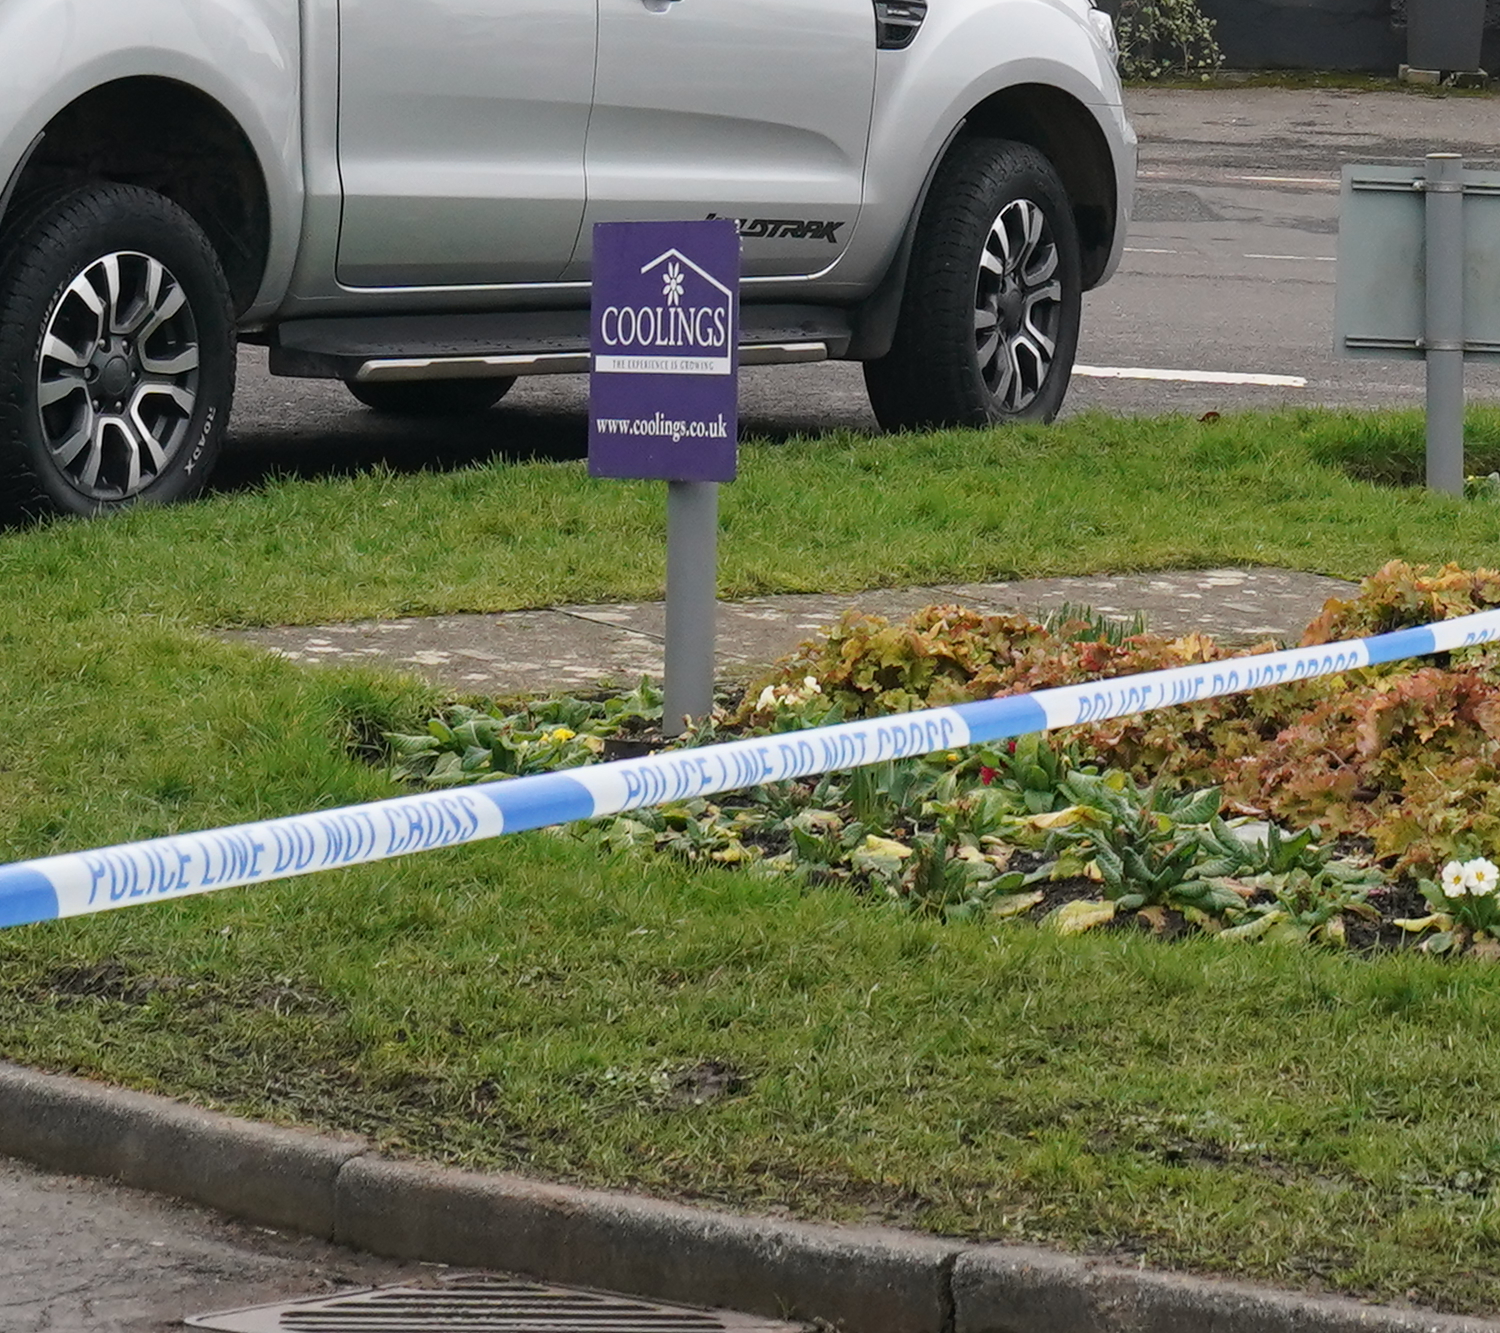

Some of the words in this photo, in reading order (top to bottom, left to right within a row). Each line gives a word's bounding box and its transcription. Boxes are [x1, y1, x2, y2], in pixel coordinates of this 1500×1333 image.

[601, 305, 726, 348] COOLINGS
[612, 359, 625, 370] THE
[627, 359, 669, 370] EXPERIENCE
[680, 359, 714, 371] GROWING
[596, 411, 728, 443] www.coolings.co.uk
[80, 839, 196, 904] POLICE
[193, 827, 269, 885] LINE
[267, 819, 318, 872] DO
[316, 810, 378, 863] NOT
[379, 792, 482, 852] CROSS
